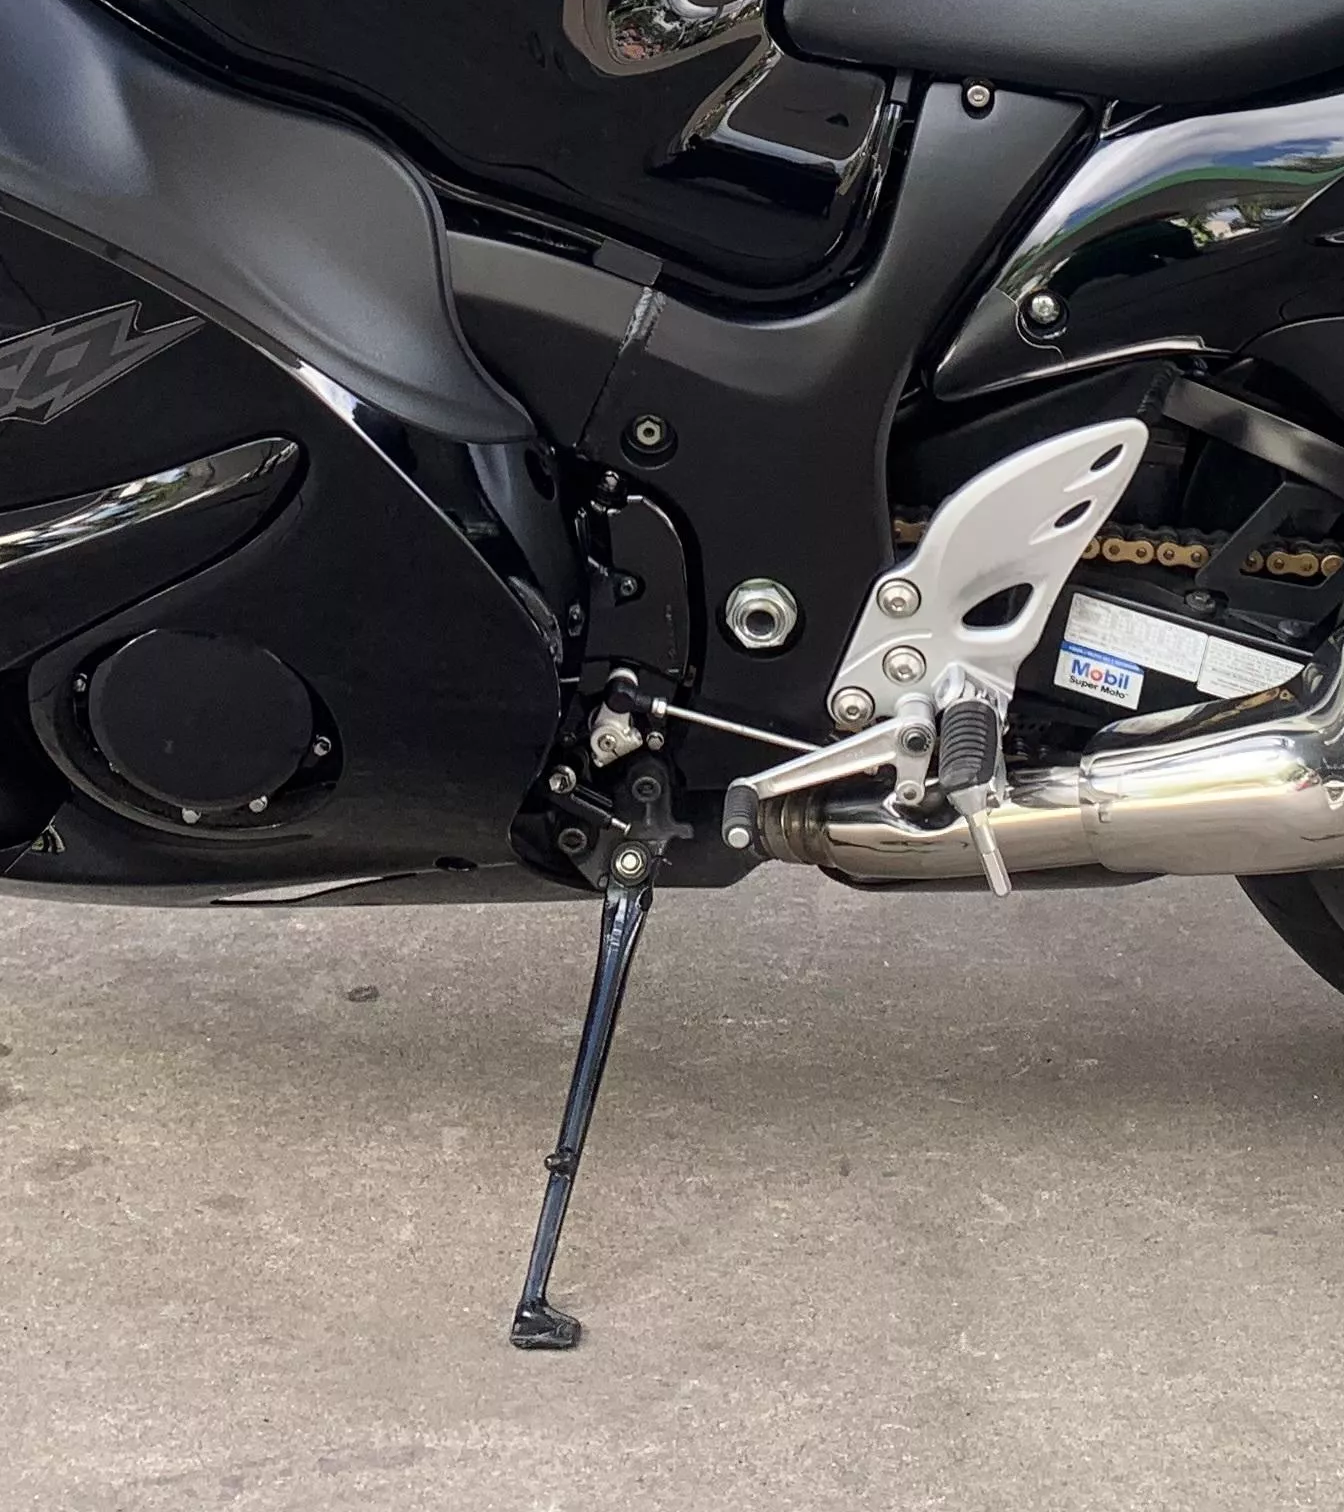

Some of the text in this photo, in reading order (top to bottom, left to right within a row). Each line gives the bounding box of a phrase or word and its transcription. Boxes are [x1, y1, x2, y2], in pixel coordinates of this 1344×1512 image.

[1069, 675, 1126, 699] Super Moto
[1071, 659, 1131, 690] Mobil
